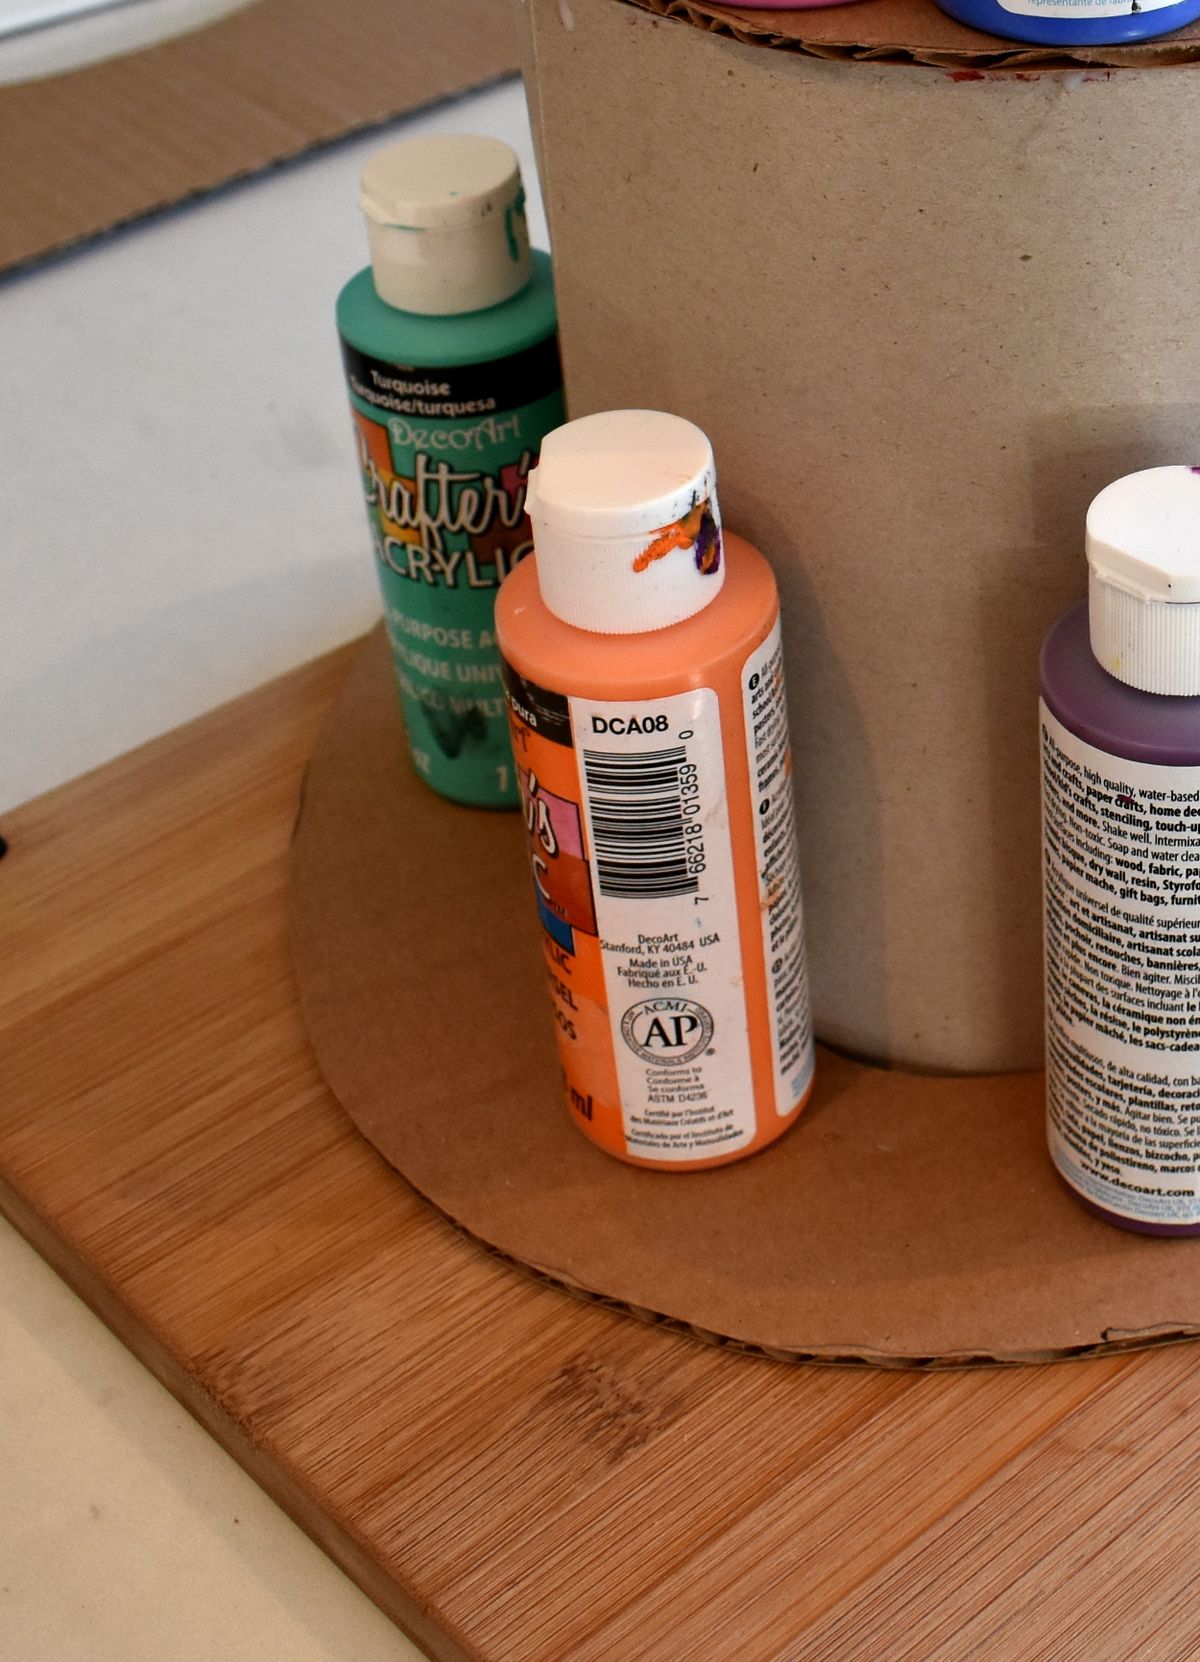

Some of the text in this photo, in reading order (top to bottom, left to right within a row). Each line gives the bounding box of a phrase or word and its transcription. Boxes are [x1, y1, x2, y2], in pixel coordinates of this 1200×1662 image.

[370, 369, 451, 396] Turquoise
[386, 412, 522, 450] DecoArt
[359, 450, 531, 552] rafter'
[592, 714, 669, 735] DCA08
[679, 763, 701, 815] 01359
[1103, 778, 1136, 799] quality,
[1139, 788, 1199, 803] water-based
[1086, 784, 1113, 805] paper
[1149, 803, 1181, 817] home
[1100, 806, 1153, 831] stenciling,
[1102, 820, 1128, 839] Shake
[684, 823, 707, 874] 66218
[1131, 846, 1149, 859] and
[1151, 851, 1179, 862] water
[1115, 857, 1146, 874] wood,
[1148, 863, 1183, 878] fabric,
[1131, 876, 1160, 891] resin,
[694, 896, 709, 905] 7
[1140, 890, 1169, 907] bags,
[637, 933, 679, 945] DecoArt
[647, 945, 660, 954] KY
[663, 940, 695, 953] 40484
[699, 933, 720, 947] USA
[1139, 929, 1187, 943] artisanat
[629, 955, 693, 968] Made in USA
[617, 966, 680, 980] Fabriqué aux
[628, 978, 675, 988] Hecho en
[643, 1000, 688, 1015] ACMI
[640, 1014, 699, 1048] AP
[645, 1067, 690, 1077] Conforms
[647, 1094, 675, 1103] ASTM
